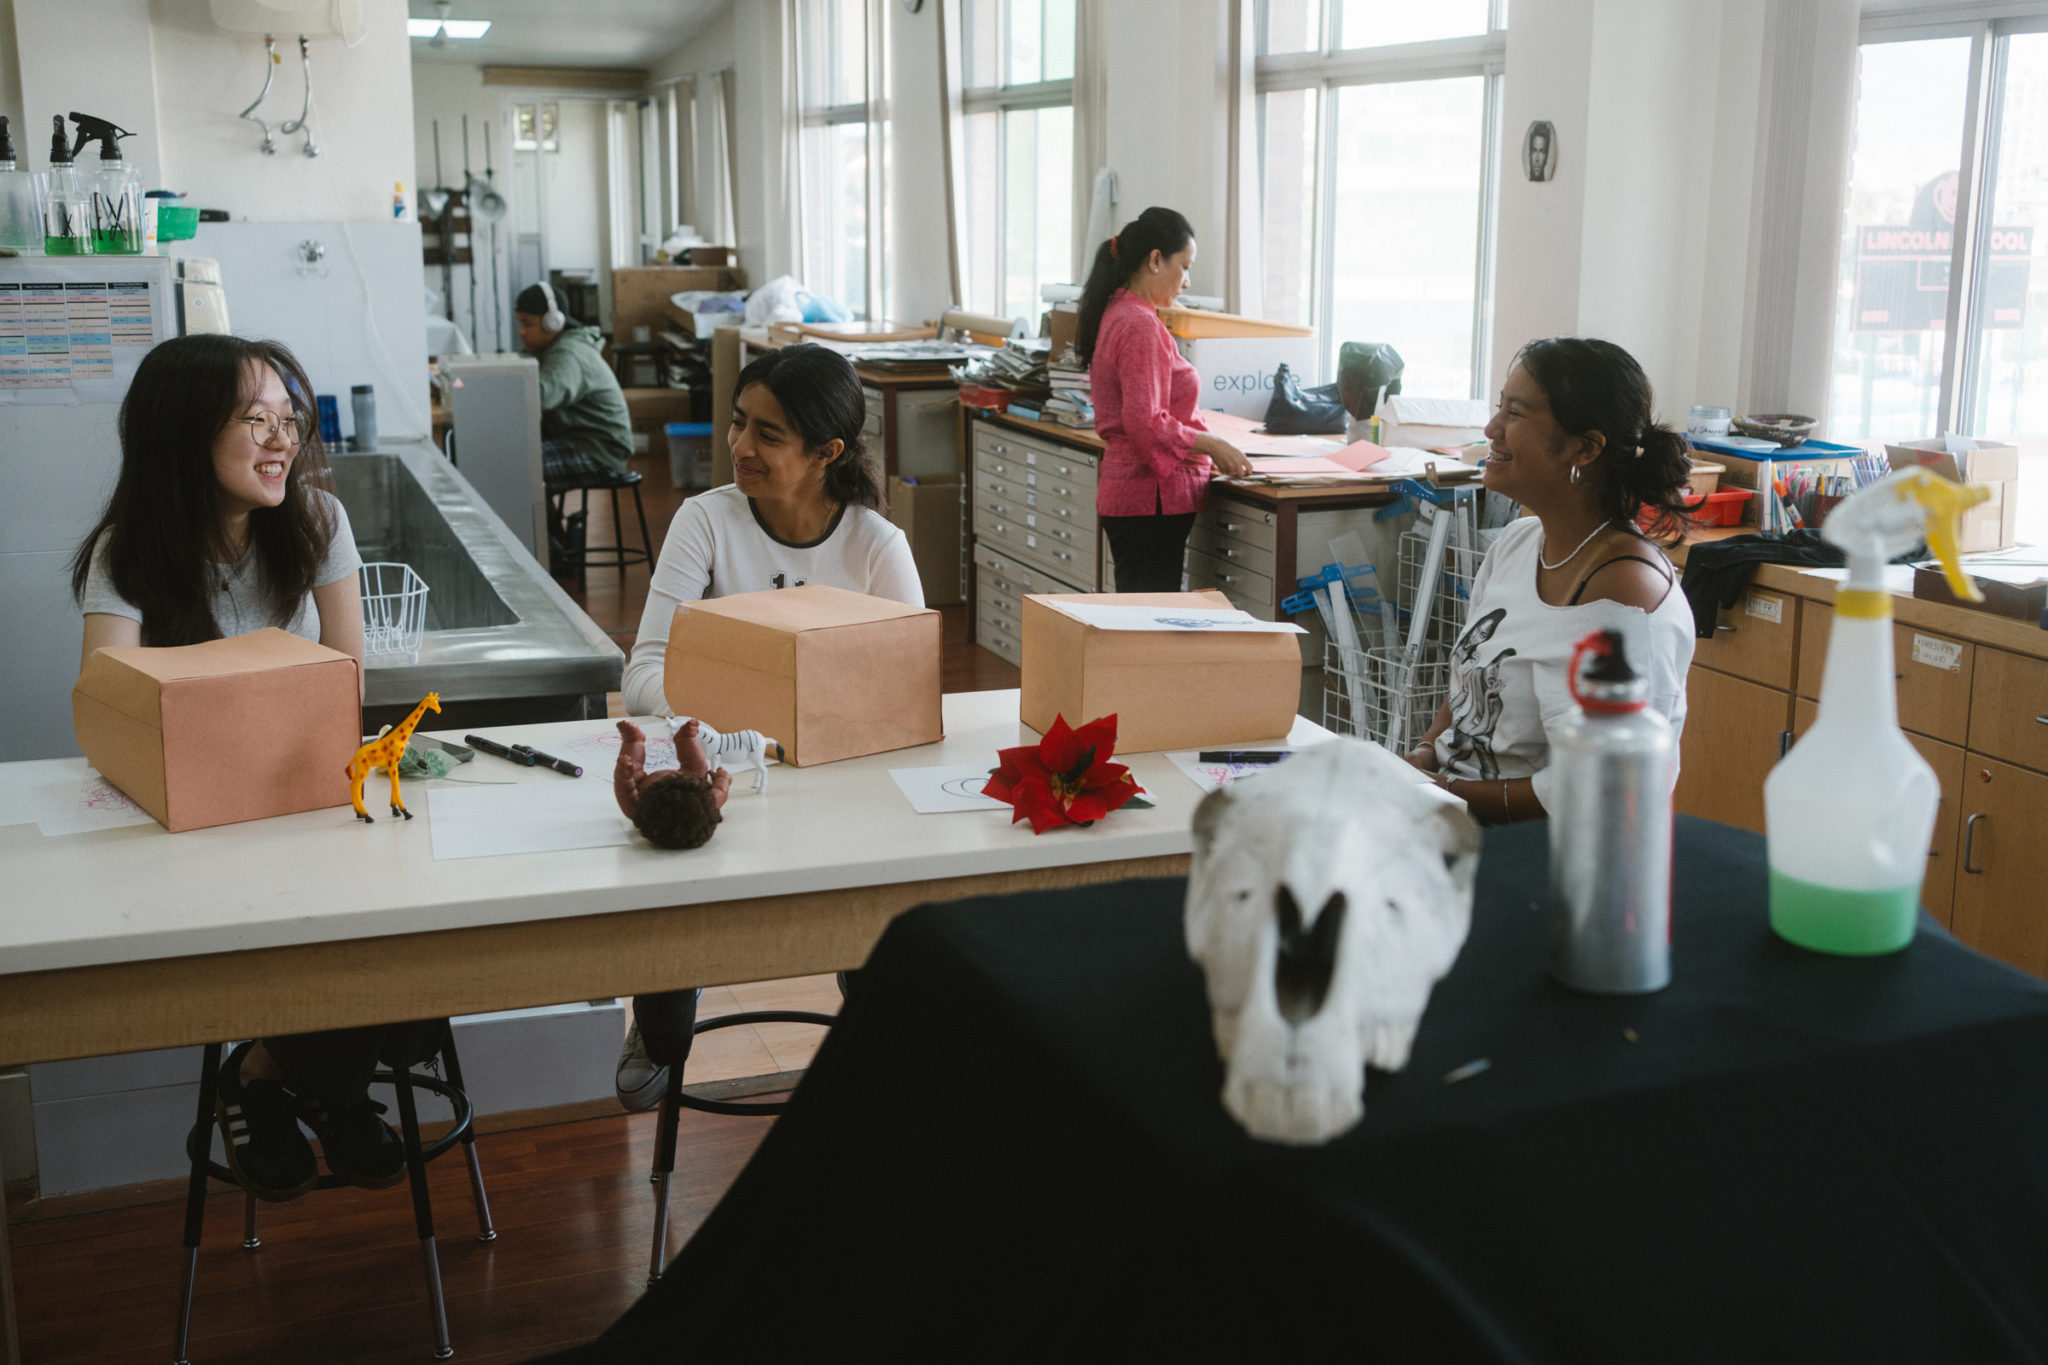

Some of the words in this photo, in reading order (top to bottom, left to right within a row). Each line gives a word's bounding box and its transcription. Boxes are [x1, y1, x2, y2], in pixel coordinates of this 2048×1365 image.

[1866, 231, 1950, 250] LINCOLN
[1990, 231, 2027, 250] OOL
[1213, 369, 1301, 395] exploe
